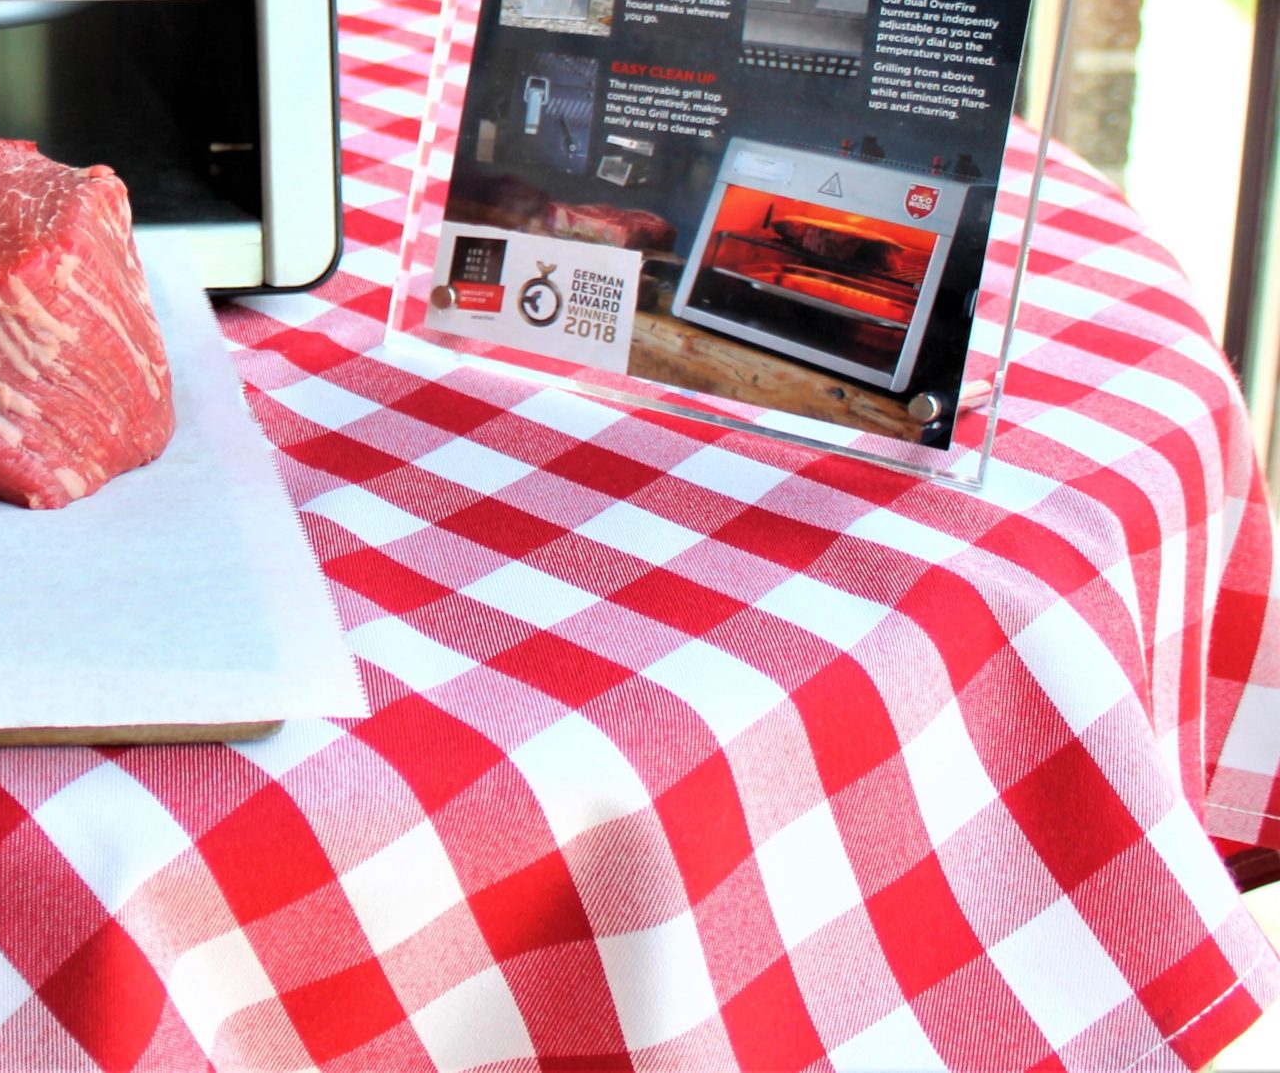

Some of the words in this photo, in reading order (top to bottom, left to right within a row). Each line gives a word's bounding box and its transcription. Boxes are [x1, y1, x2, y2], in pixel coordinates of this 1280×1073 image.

[626, 0, 653, 10] house
[655, 3, 684, 14] steaks
[686, 7, 730, 19] wherever
[880, 7, 920, 19] burners
[923, 13, 940, 22] are
[930, 0, 976, 13] OverFire
[624, 13, 641, 21] you
[643, 15, 659, 23] go.
[879, 20, 933, 33] adjustable
[950, 28, 970, 38] you
[973, 31, 992, 40] can
[877, 33, 925, 46] precisely
[927, 37, 946, 47] dial
[949, 40, 963, 50] up
[965, 42, 983, 52] the
[876, 44, 941, 60] temperature
[943, 53, 963, 62] you
[966, 54, 996, 66] need.
[611, 61, 647, 75] EASY
[649, 66, 694, 81] CLEAN
[696, 71, 716, 84] UP
[874, 62, 911, 76] Grilling
[914, 68, 939, 78] from
[941, 71, 975, 82] above
[609, 79, 626, 89] The
[629, 82, 680, 96] removable
[682, 89, 702, 99] grill
[704, 92, 721, 102] top
[872, 76, 912, 88] ensures
[914, 81, 940, 90] even
[942, 83, 985, 97] cooking
[607, 92, 637, 103] comes
[639, 95, 653, 104] off
[654, 98, 691, 111] entirely,
[693, 103, 728, 116] making
[870, 88, 898, 99] while
[900, 91, 959, 107] eliminating
[961, 97, 990, 109] flare-
[606, 103, 621, 113] the
[624, 105, 646, 116] Otto
[648, 108, 669, 119] Grill
[671, 113, 719, 125] extraordi-
[869, 100, 888, 110] ups
[890, 101, 910, 112] and
[912, 104, 959, 119] charring.
[604, 116, 631, 127] narily
[633, 119, 655, 131] easy
[657, 122, 668, 131] to
[670, 125, 696, 135] clean
[698, 129, 714, 138] up.
[571, 279, 622, 300] DESIGN
[573, 269, 624, 289] GERMAN
[569, 293, 620, 313] AWARD
[567, 304, 617, 325] WINNER
[564, 316, 617, 344] 2018
